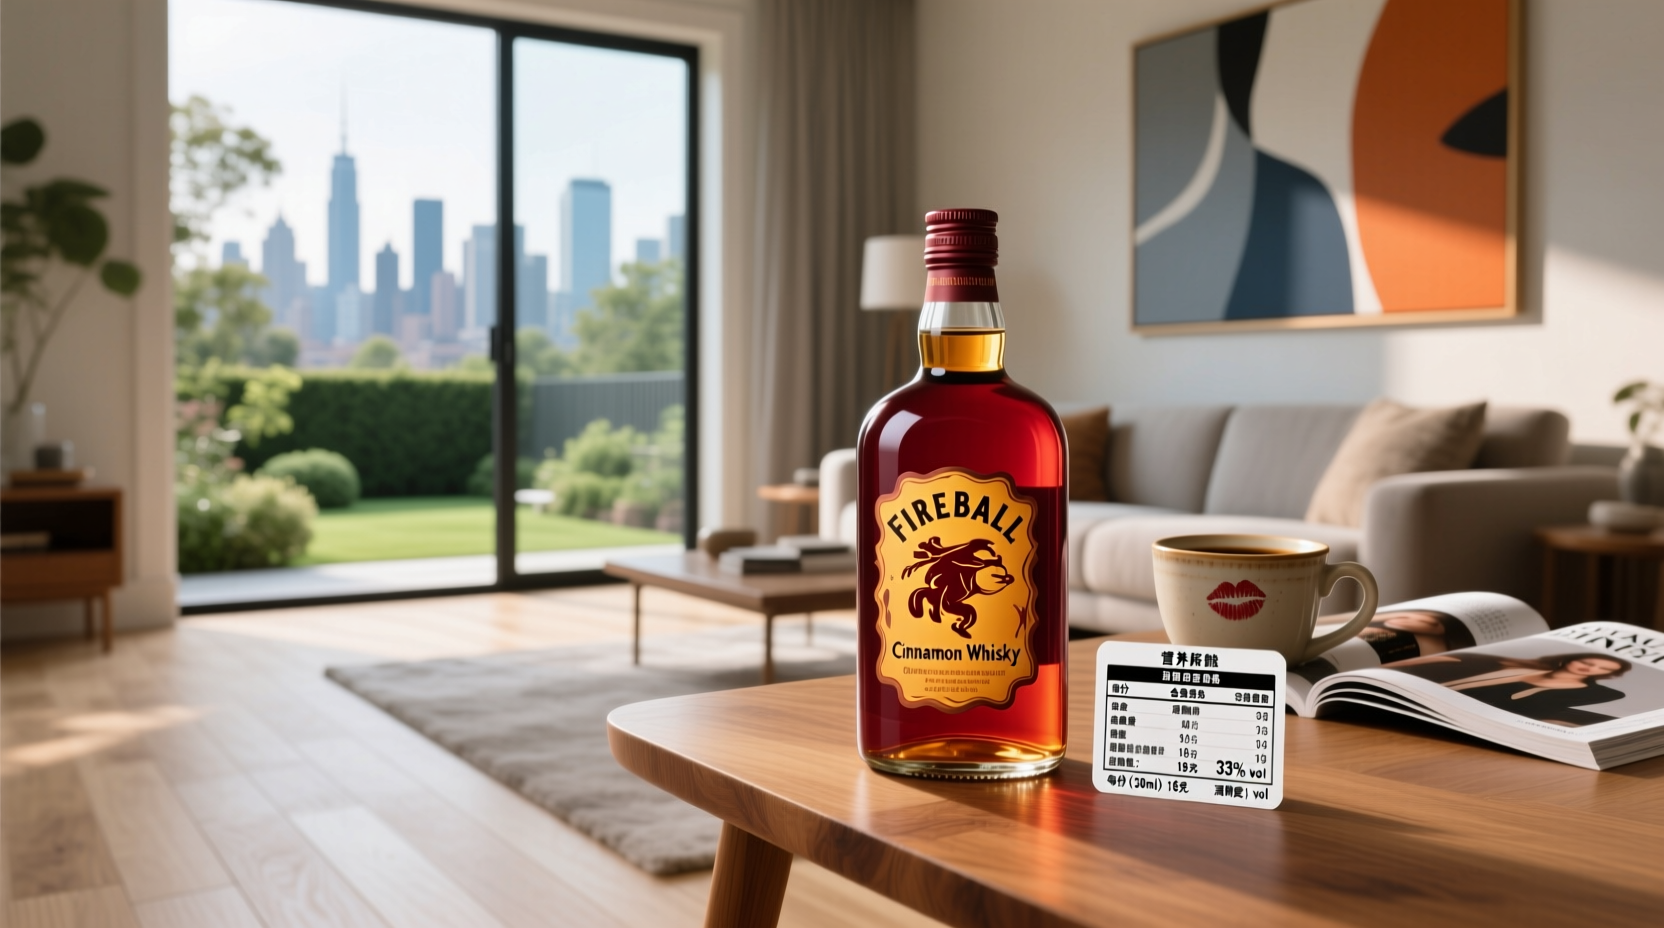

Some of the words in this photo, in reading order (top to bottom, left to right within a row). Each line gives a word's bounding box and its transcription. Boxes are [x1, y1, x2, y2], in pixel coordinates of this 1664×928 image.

[887, 491, 1024, 544] FIREBALL
[892, 641, 962, 660] Cinnamon
[966, 643, 1021, 666] Whisky
[1216, 759, 1246, 777] 33%
[1249, 767, 1266, 779] vol
[1252, 787, 1269, 800] vol
